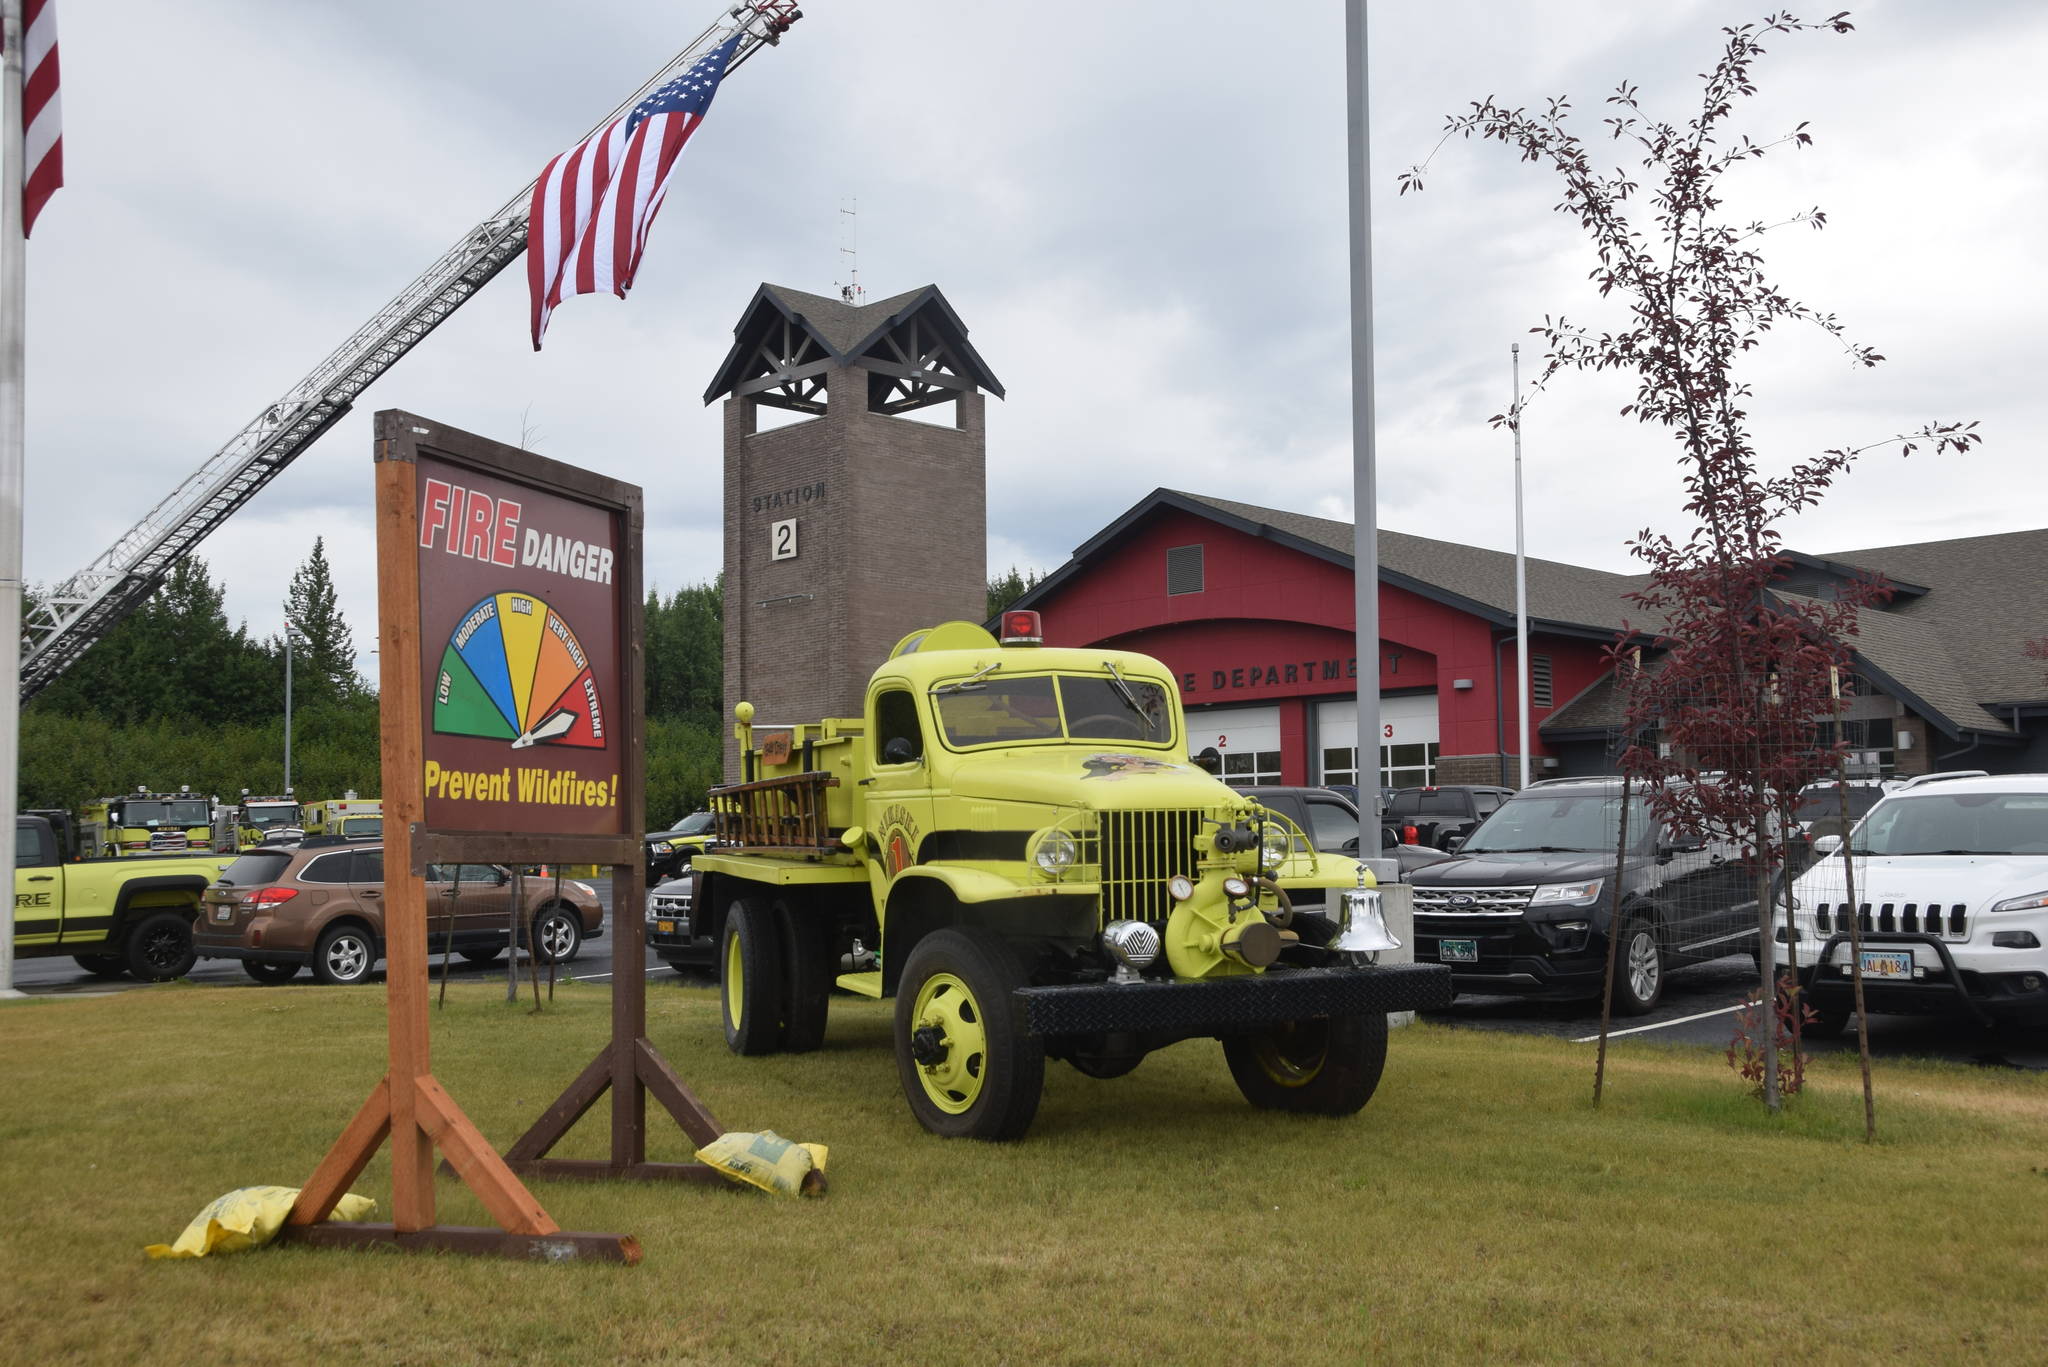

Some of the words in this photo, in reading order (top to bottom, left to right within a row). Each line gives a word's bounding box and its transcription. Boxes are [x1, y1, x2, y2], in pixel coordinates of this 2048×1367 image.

[752, 482, 825, 512] STATION
[420, 478, 521, 568] FIRE
[522, 528, 614, 585] DANGER
[778, 525, 791, 555] 2
[512, 597, 533, 616] HIGH
[455, 603, 495, 651] MODERATE
[549, 616, 569, 642] VERY
[567, 636, 584, 669] HIGH
[438, 671, 452, 705] LOW
[1212, 653, 1403, 690] DEPARTMET
[583, 678, 602, 738] EXTREME
[1218, 735, 1227, 748] 2
[1384, 724, 1394, 738] 3
[425, 760, 511, 802] Prevent
[517, 768, 618, 807] Wildfires!
[890, 836, 904, 873] 1
